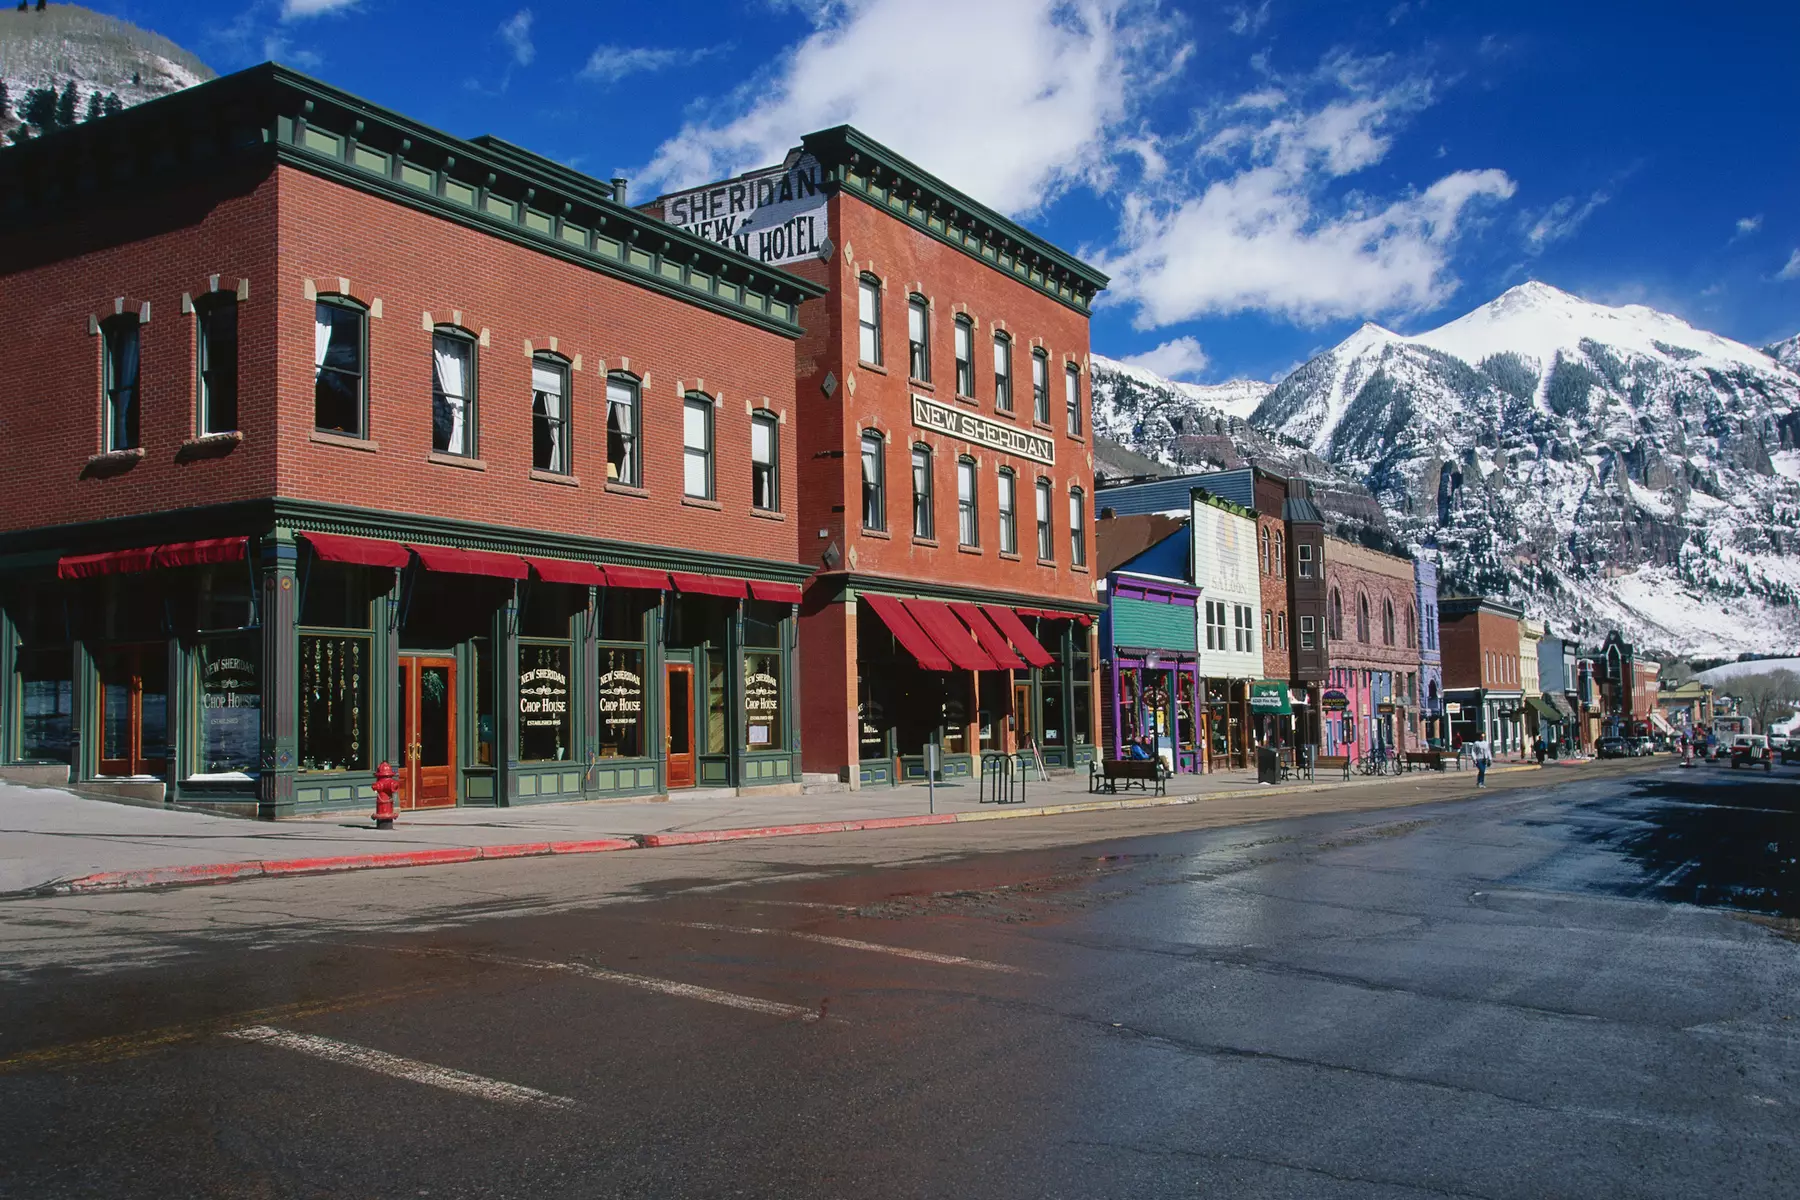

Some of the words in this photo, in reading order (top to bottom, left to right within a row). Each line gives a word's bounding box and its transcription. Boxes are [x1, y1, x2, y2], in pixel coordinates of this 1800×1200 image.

[671, 167, 816, 225] SHERIDAN
[759, 216, 820, 261] HOTEL
[916, 401, 958, 430] NEW
[962, 416, 1049, 458] SHERIDAN
[1212, 576, 1246, 595] SALOON
[205, 660, 220, 678] NEW
[220, 657, 254, 676] SHERIDAN
[521, 669, 535, 685] NEW
[536, 669, 566, 685] SHERIDAN
[600, 670, 613, 686] NEW
[614, 670, 640, 685] SHERIDAN
[746, 674, 755, 687] NEW
[756, 674, 776, 687] SHERIDAN
